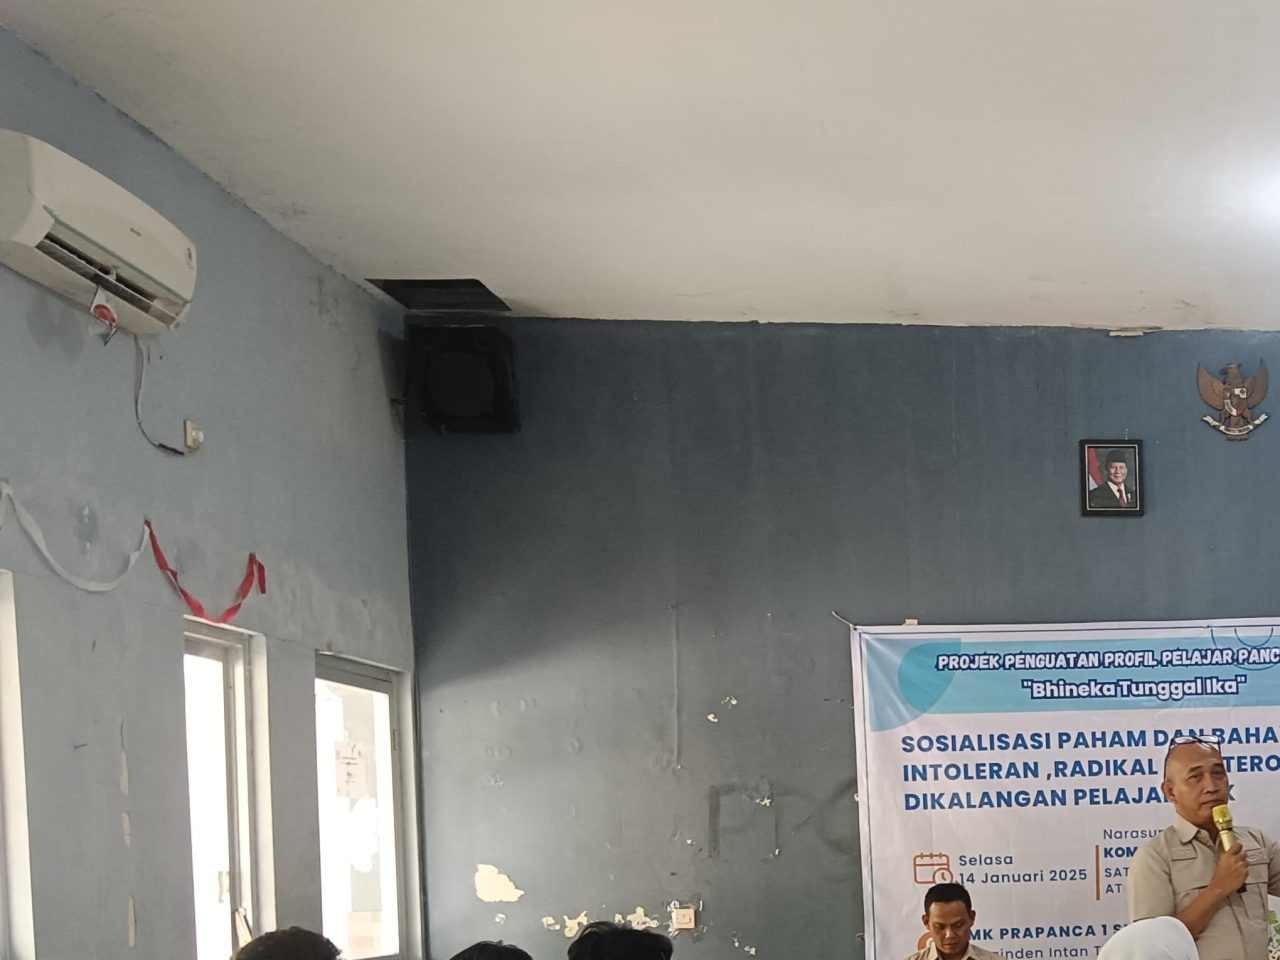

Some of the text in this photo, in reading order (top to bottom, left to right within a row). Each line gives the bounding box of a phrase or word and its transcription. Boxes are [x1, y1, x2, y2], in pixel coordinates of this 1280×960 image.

[937, 654, 1000, 671] PROJEK
[1003, 652, 1100, 670] PENGUATAN
[1103, 650, 1158, 669] PROFIL
[1162, 649, 1233, 667] PELAJAR
[1022, 675, 1247, 701] "Bhineka Tunggal Ika"
[901, 732, 1052, 753] SOSIALISASI
[1058, 730, 1147, 750] PAHAM
[903, 761, 1039, 782] INTOLERAN
[904, 786, 1173, 811] DIKALANGAN PELAJA
[1103, 829, 1163, 839] Narasu
[959, 853, 1013, 866] Selasa
[959, 868, 1088, 885] 14 Januari 2025
[970, 928, 994, 940] MK
[999, 924, 1096, 940] PRAPANCA
[1101, 924, 1107, 936] 1
[1049, 946, 1088, 958] Intan
